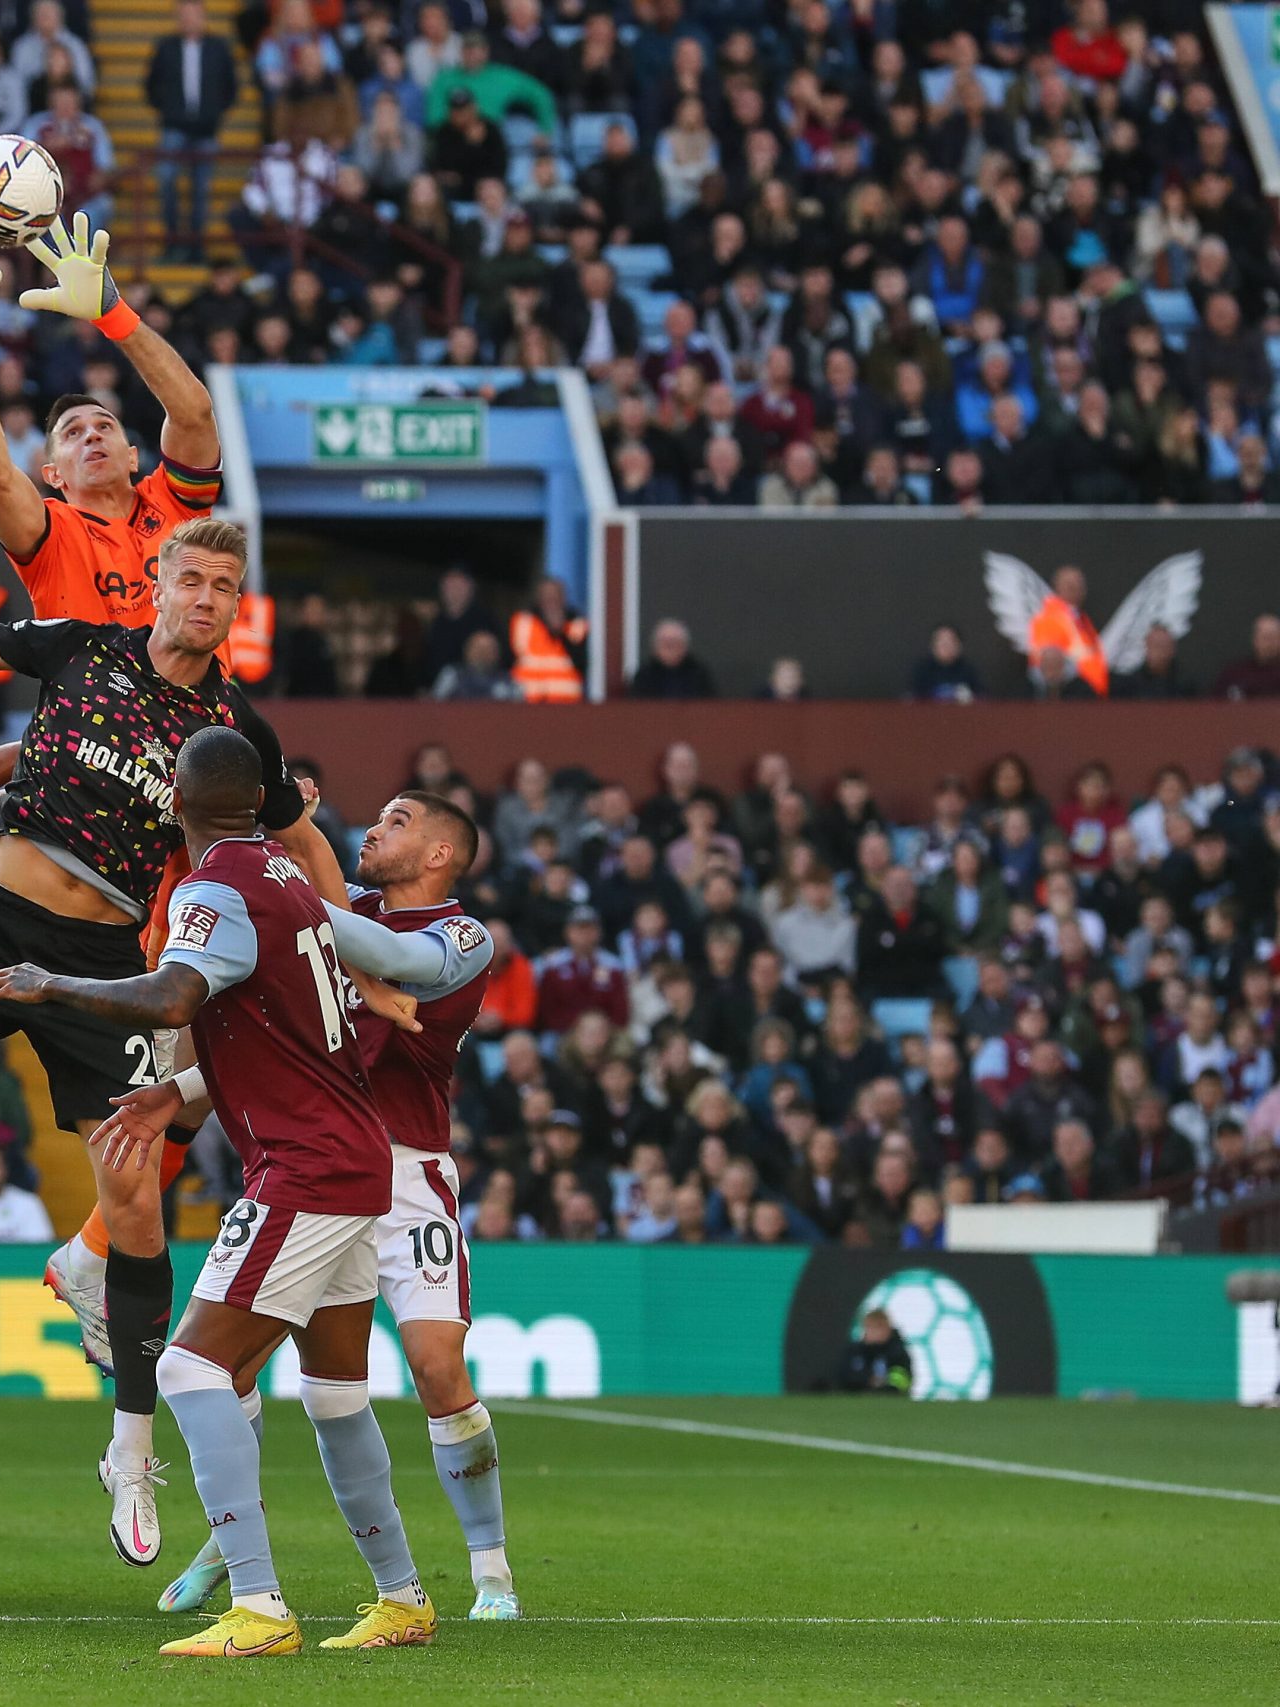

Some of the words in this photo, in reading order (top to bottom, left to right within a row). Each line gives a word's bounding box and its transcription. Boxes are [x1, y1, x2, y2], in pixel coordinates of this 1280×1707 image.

[398, 415, 475, 451] EXIT
[94, 555, 159, 600] CAZO
[108, 681, 128, 696] umbro
[76, 738, 176, 816] HOLLYWO
[408, 1221, 454, 1269] 10
[208, 1511, 237, 1528] LLA
[348, 1525, 381, 1538] LLA
